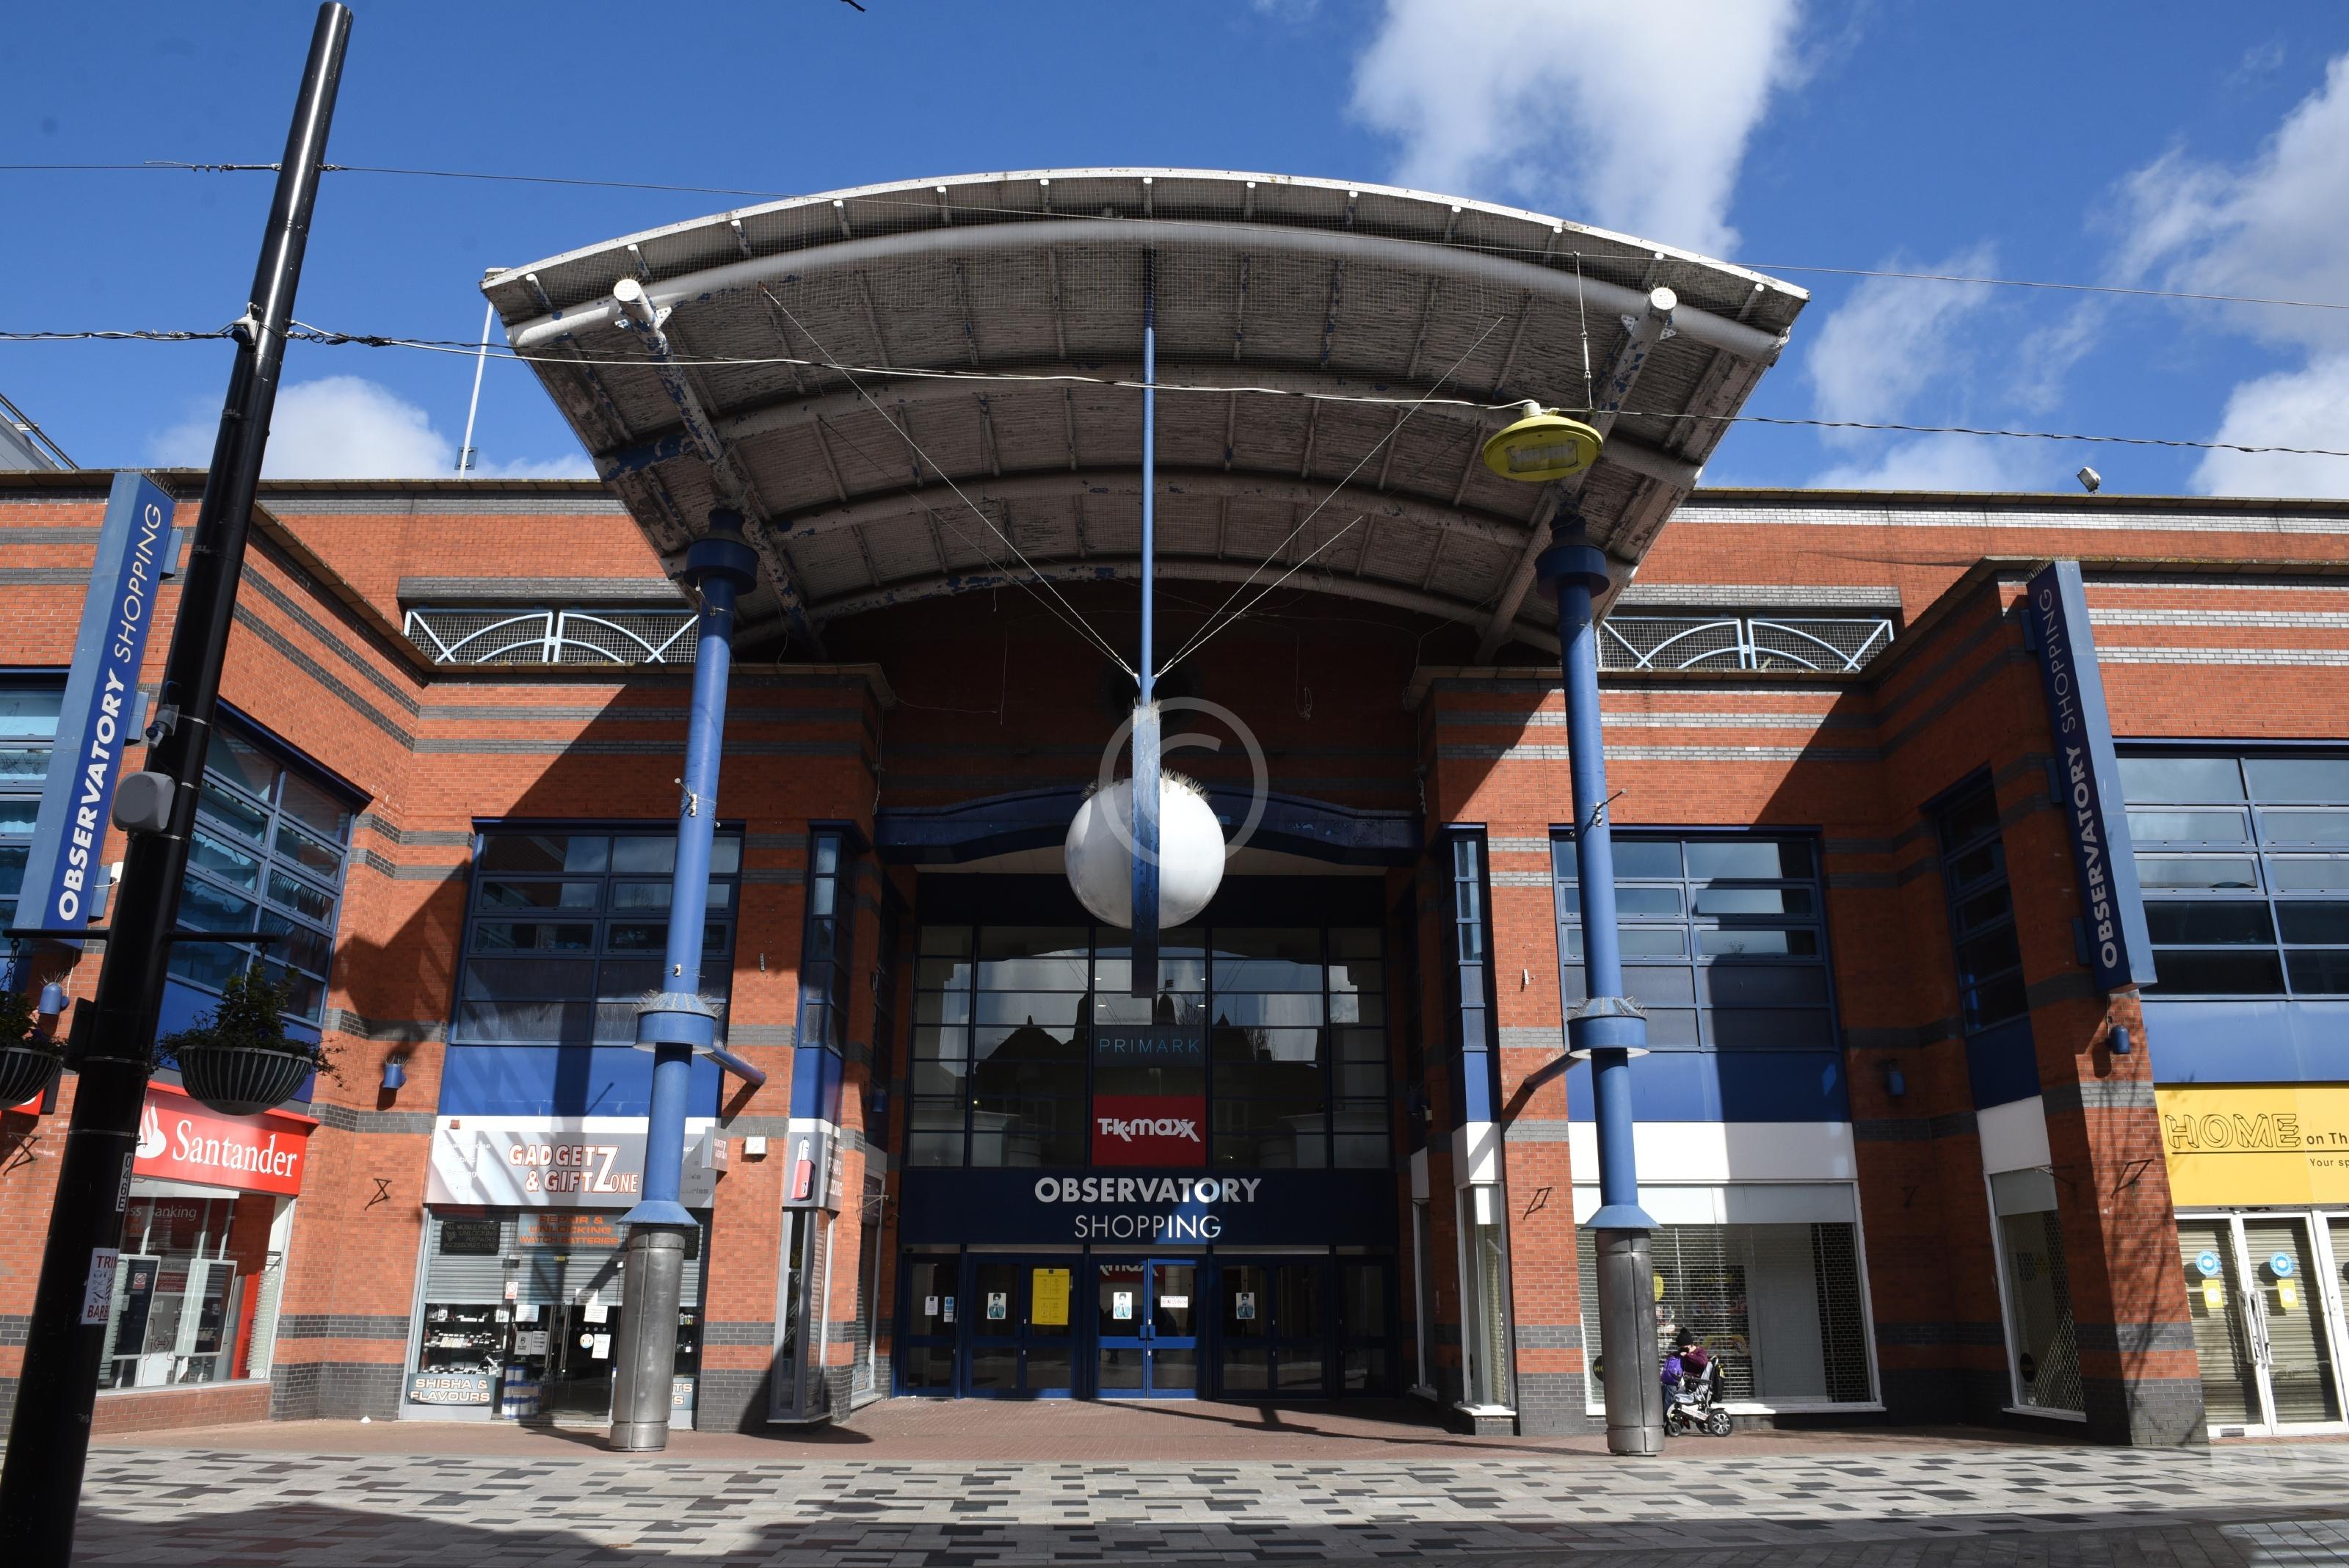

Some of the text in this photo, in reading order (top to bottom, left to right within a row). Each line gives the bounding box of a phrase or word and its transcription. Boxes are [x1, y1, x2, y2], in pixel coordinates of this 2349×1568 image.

[59, 502, 161, 921] OBSERVATORY SHOPPING
[2038, 588, 2118, 969] OBSERVATORY SHOPPING
[1099, 1039, 1200, 1053] PRIMARK
[2165, 1114, 2301, 1149] HOME
[2306, 1135, 2324, 1145] on
[173, 1119, 297, 1178] Santander
[508, 1144, 596, 1167] GADGET
[2310, 1158, 2334, 1167] Your
[525, 1170, 540, 1192] &
[544, 1171, 594, 1193] GIFT
[1034, 1177, 1262, 1203] OBSERVATORY
[153, 1205, 197, 1221] anking
[538, 1215, 604, 1224] REPAIR &
[529, 1225, 612, 1234] UNLOCKING
[1074, 1215, 1221, 1238] SHOPPING
[520, 1235, 619, 1245] WATCH BATTERIES
[415, 1378, 488, 1389] SHISHA &
[410, 1390, 490, 1402] FLAVOURS
